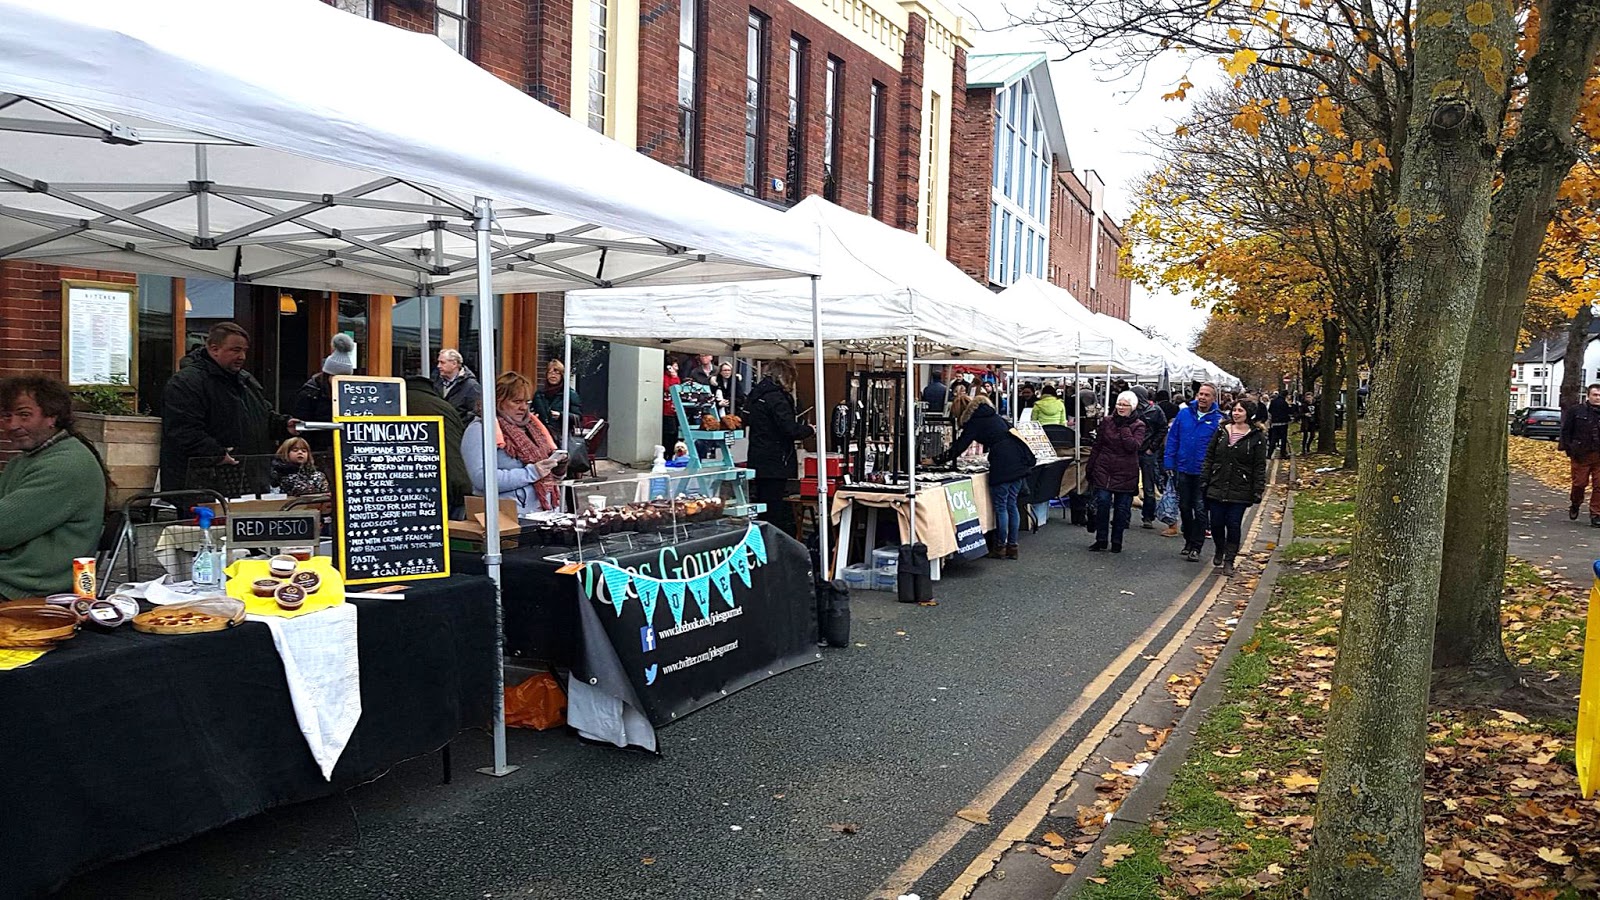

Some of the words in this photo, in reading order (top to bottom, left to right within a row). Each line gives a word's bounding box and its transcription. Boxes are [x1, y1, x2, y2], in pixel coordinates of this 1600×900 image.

[344, 384, 378, 394] PESTO
[346, 423, 428, 441] HEMINGWAYS
[236, 521, 264, 536] RED
[268, 519, 308, 536] PESTO
